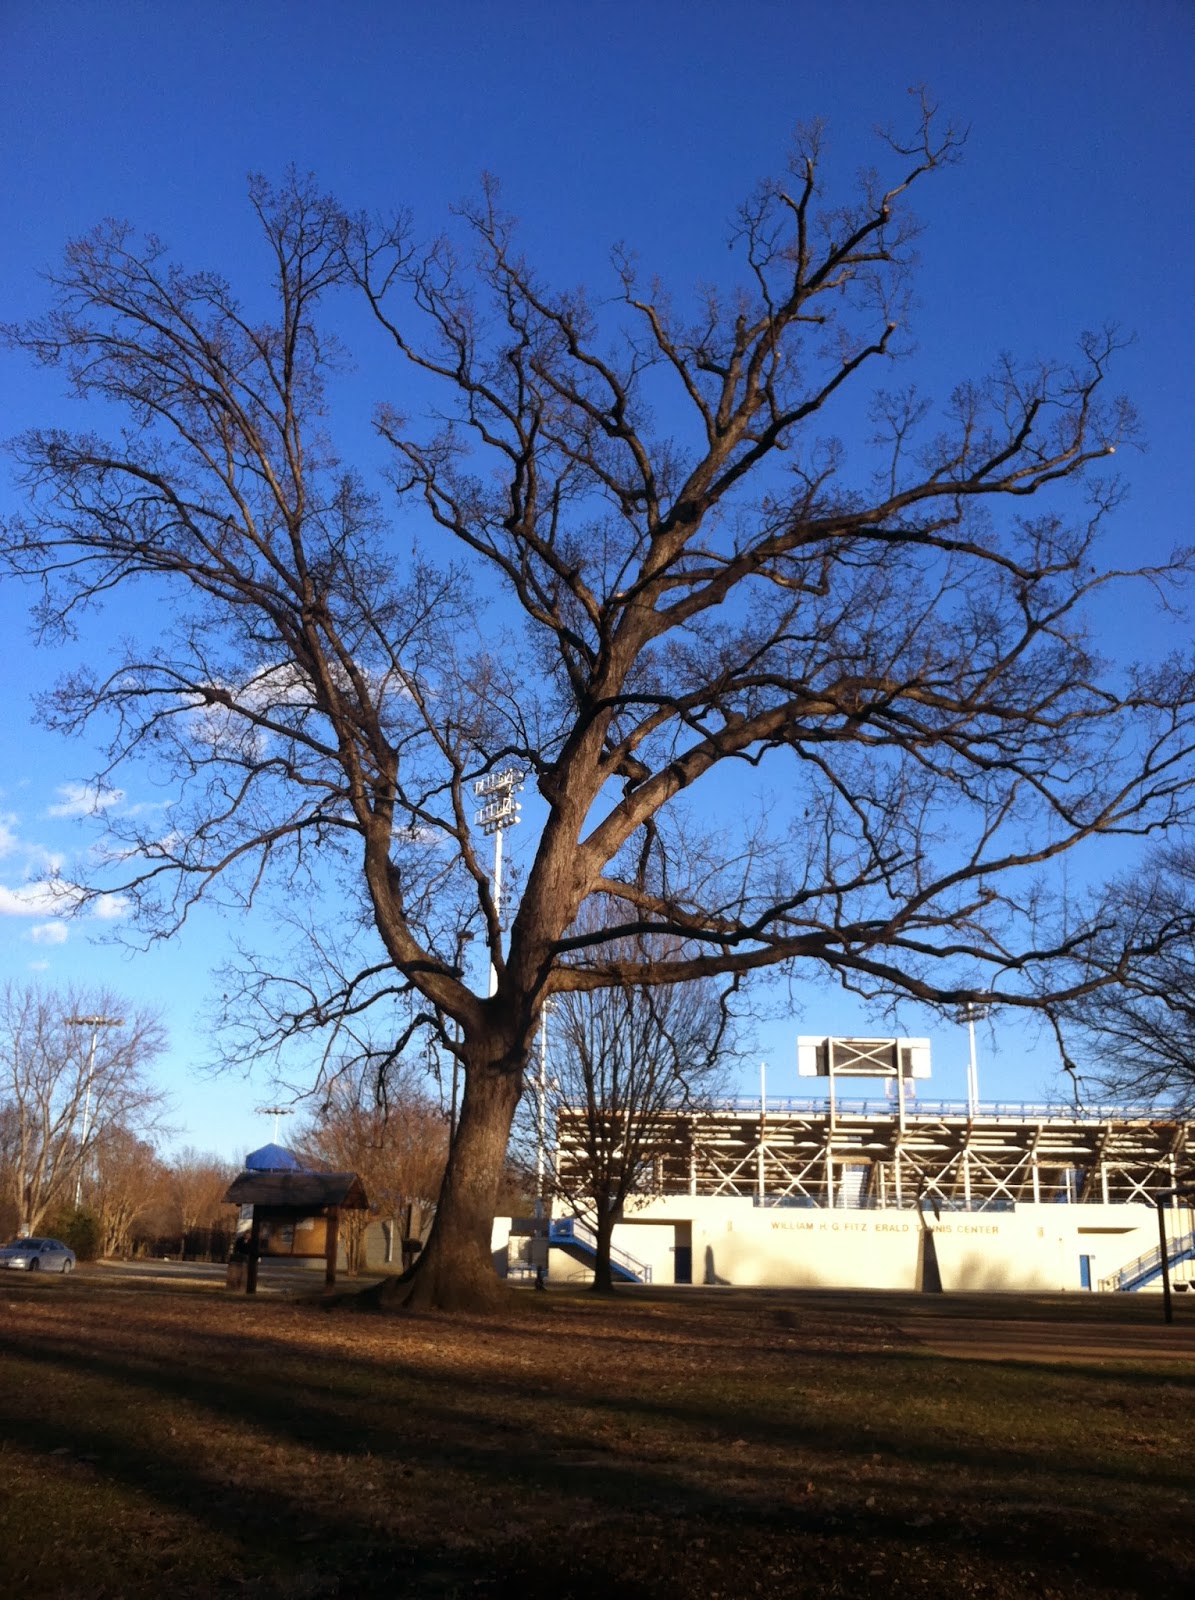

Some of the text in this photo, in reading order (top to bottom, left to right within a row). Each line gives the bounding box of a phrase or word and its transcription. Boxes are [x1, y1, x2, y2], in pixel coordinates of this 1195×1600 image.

[771, 1222, 814, 1231] WILLIAM
[915, 1224, 952, 1233] TNNIS
[957, 1225, 999, 1234] CENTER
